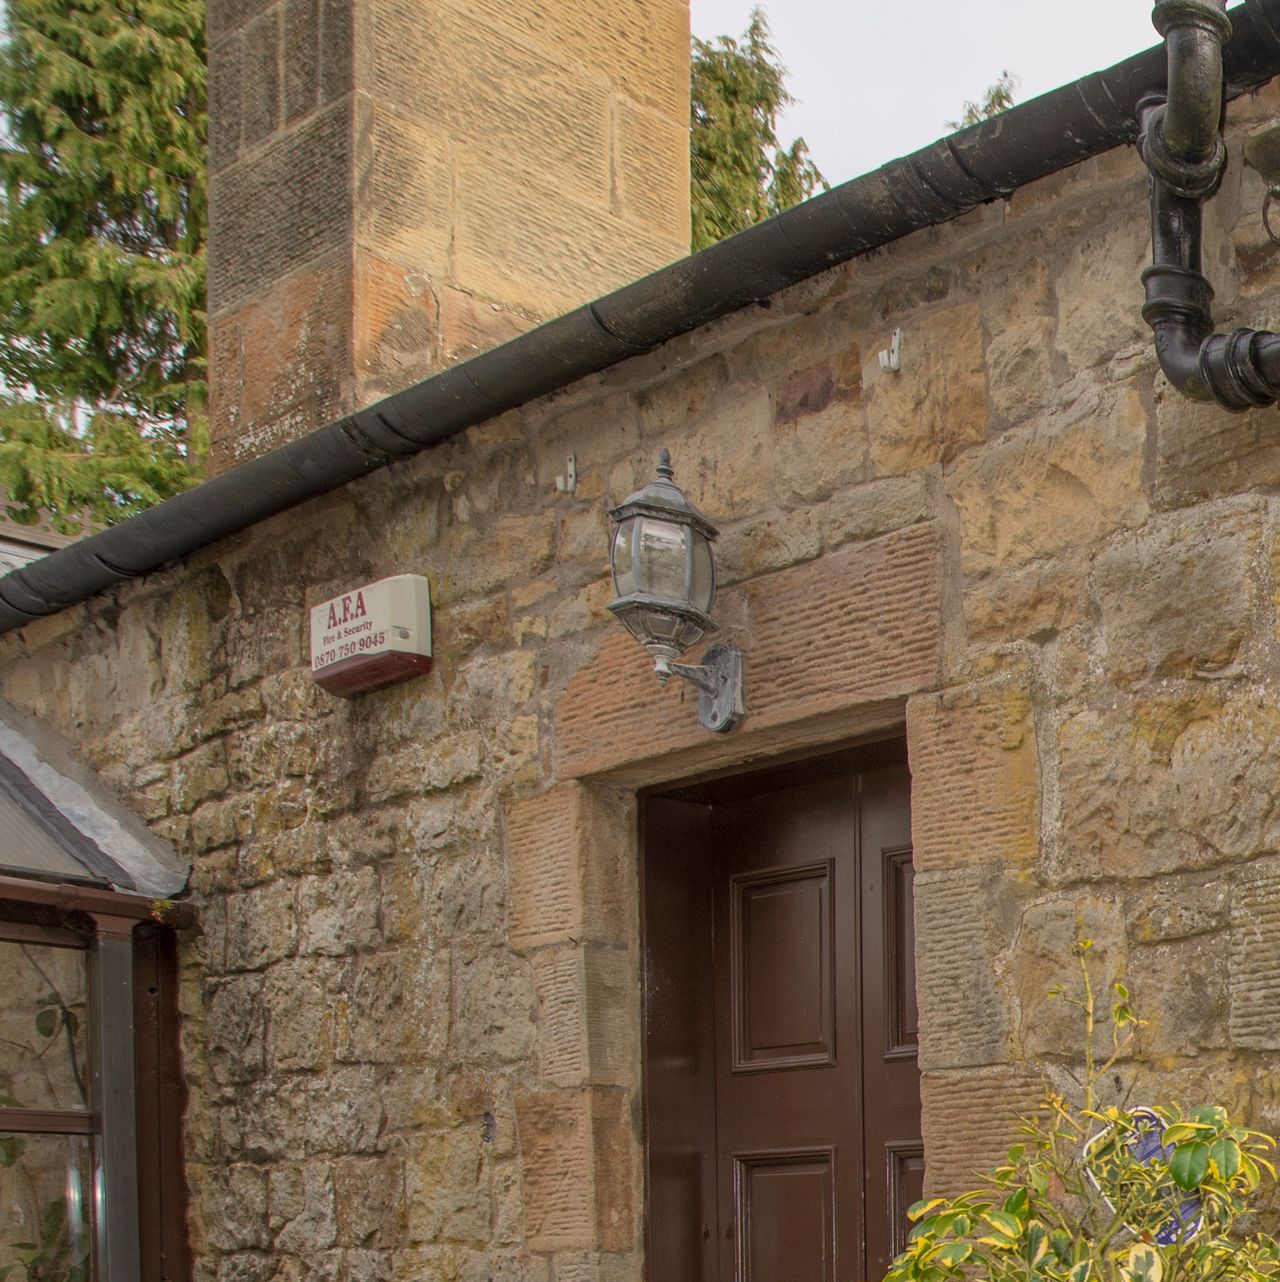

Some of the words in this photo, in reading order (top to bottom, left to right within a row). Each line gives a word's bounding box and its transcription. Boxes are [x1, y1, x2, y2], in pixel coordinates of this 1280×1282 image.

[327, 591, 367, 630] A.F.A
[315, 649, 336, 669] 0870
[338, 641, 356, 658] 750
[359, 632, 385, 651] 9045
[323, 635, 335, 646] Fire
[337, 630, 342, 640] &
[344, 621, 373, 638] Security
